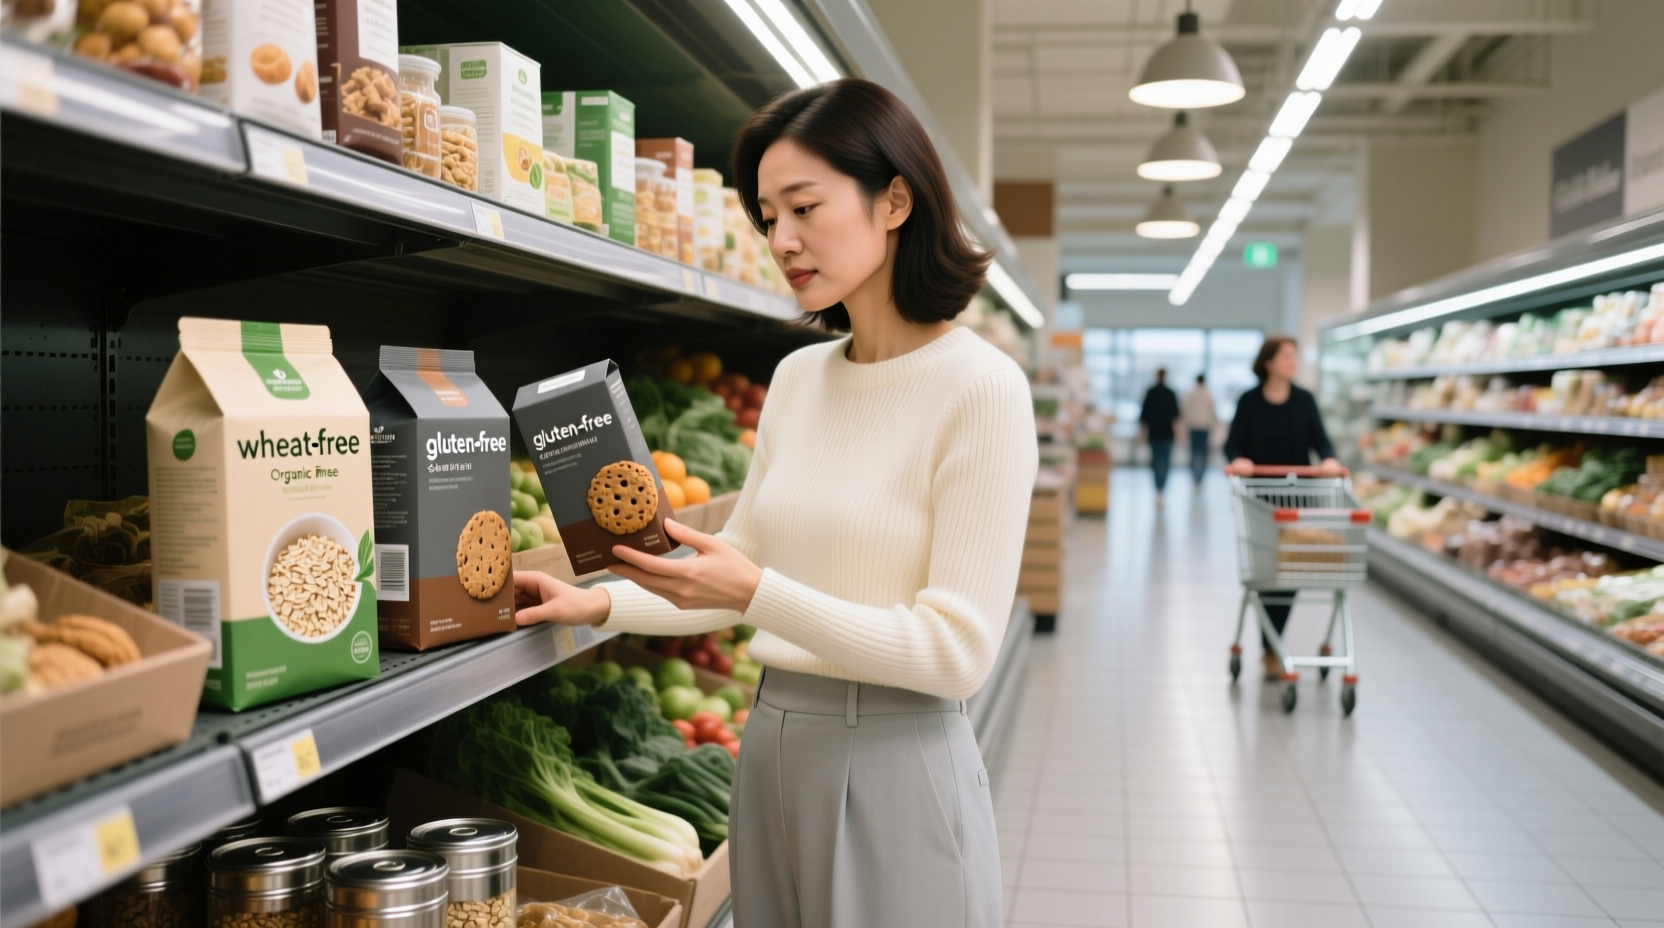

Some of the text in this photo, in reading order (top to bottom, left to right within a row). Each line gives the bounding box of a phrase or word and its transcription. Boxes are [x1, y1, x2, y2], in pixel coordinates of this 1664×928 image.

[237, 428, 360, 459] wheat-free
[426, 430, 506, 461] gluten-free
[533, 413, 612, 451] gluten-free
[271, 465, 312, 484] Organic
